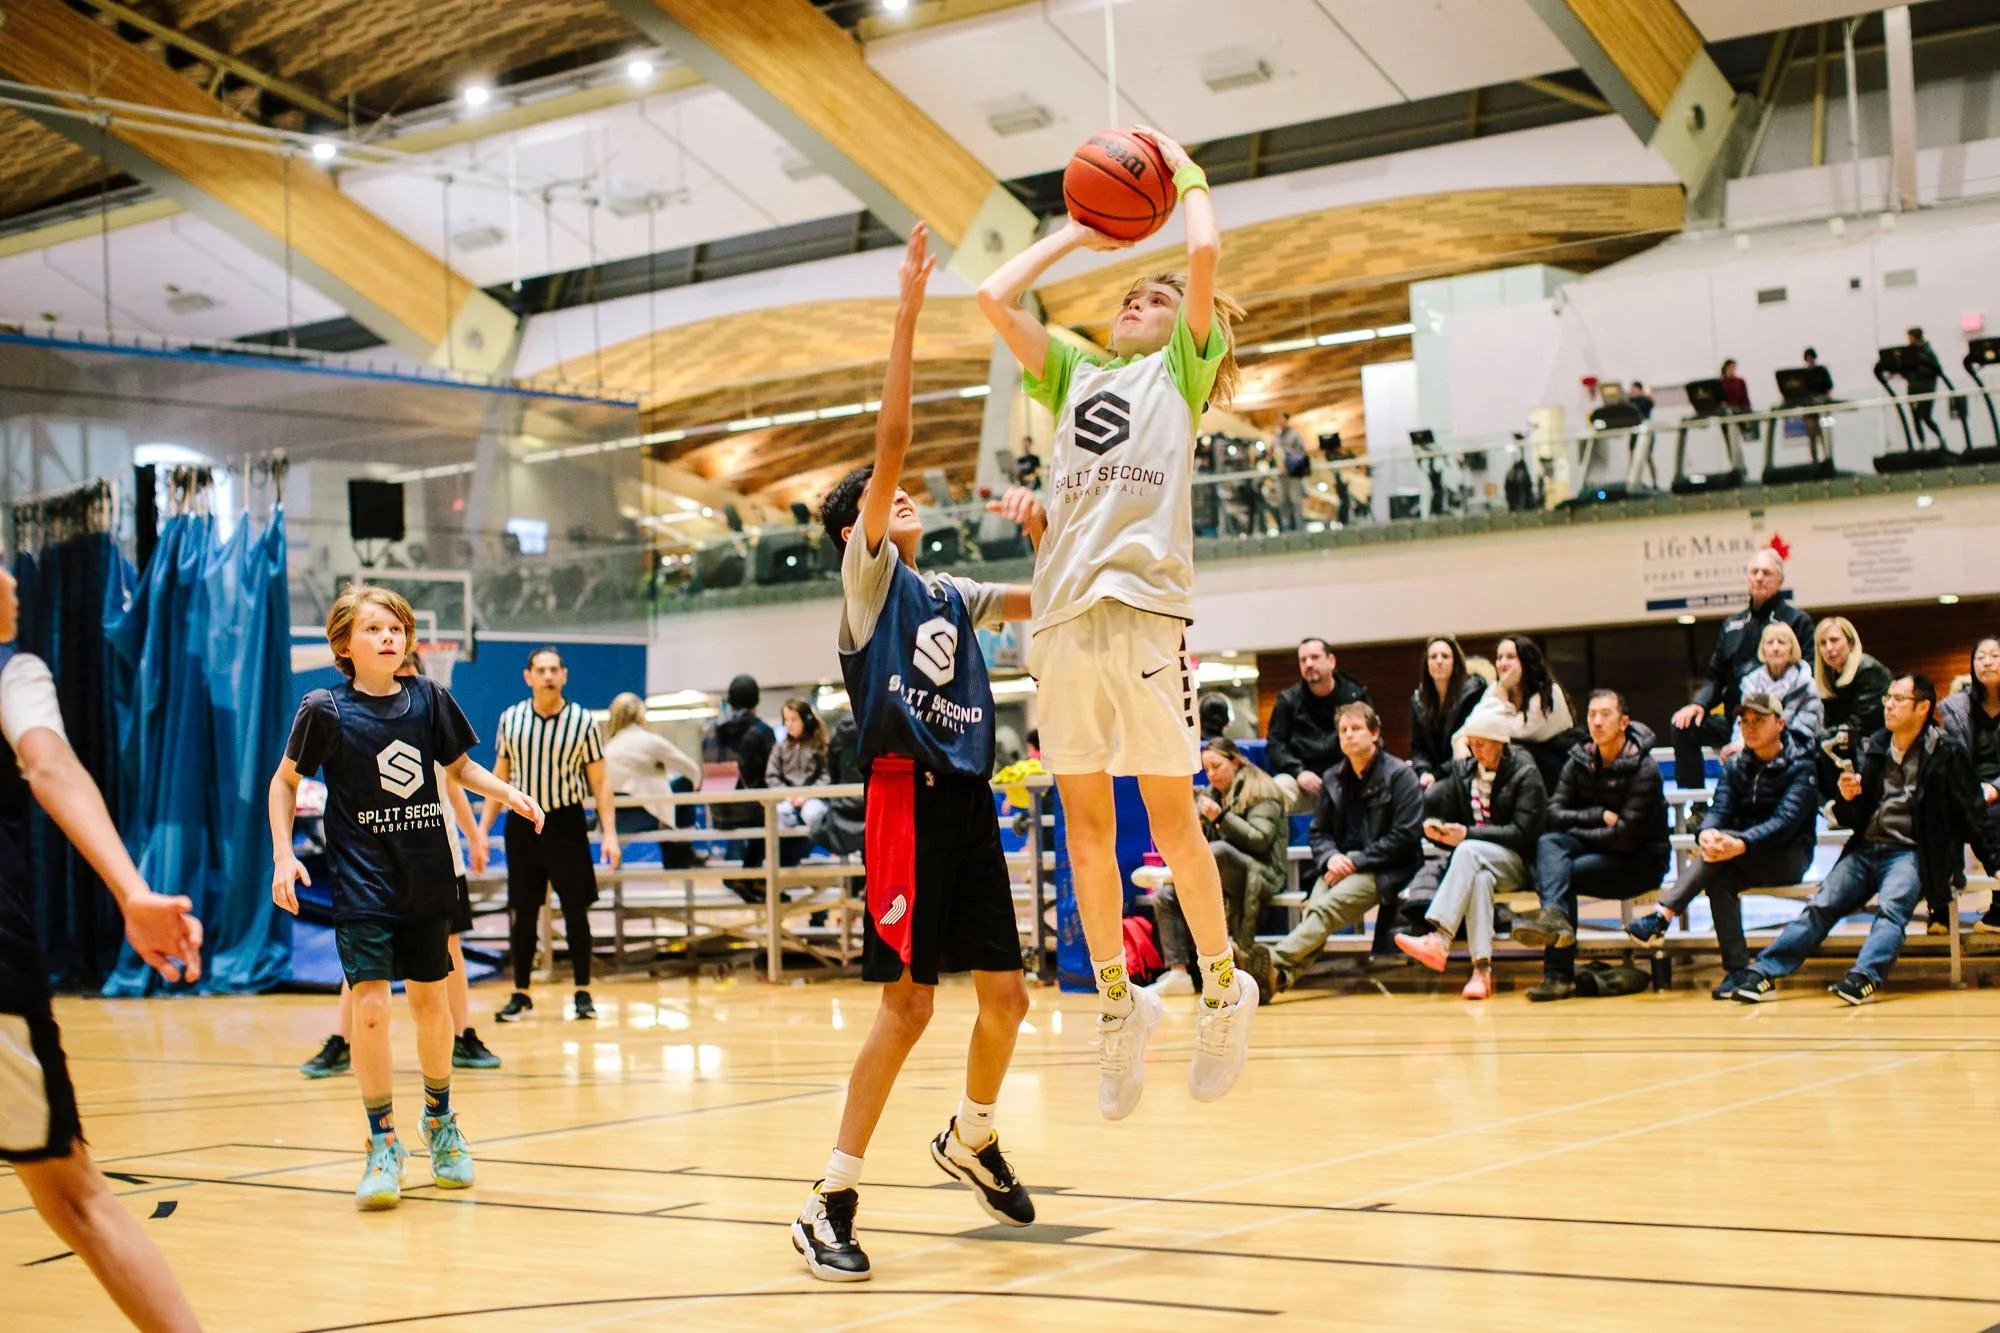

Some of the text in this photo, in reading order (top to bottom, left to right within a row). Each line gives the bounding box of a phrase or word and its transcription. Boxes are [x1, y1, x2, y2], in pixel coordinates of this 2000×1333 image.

[1098, 465, 1165, 486] SECOND
[1065, 484, 1144, 504] BAKETALL
[888, 674, 983, 723] SIT SECOND
[909, 705, 966, 734] SKETBALL
[358, 802, 443, 824] SPLIT SECON
[373, 818, 440, 833] BASKETBALL
